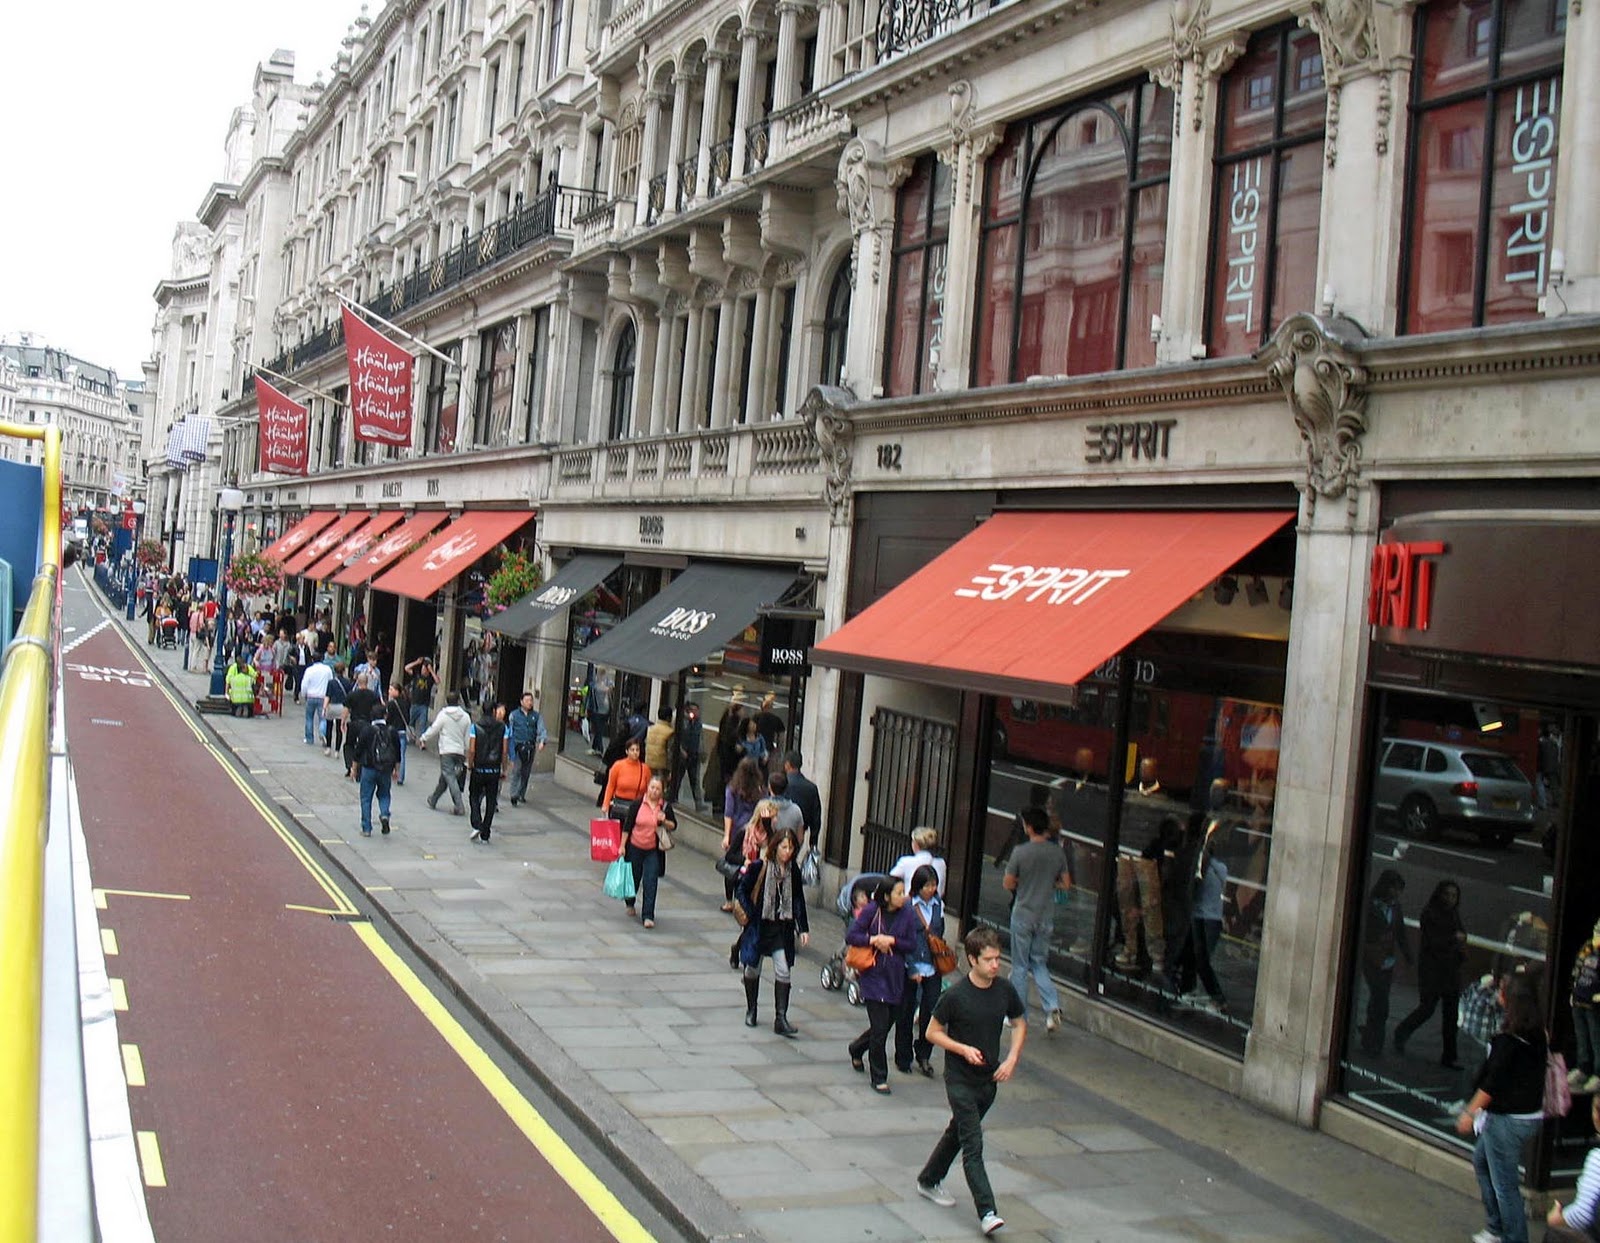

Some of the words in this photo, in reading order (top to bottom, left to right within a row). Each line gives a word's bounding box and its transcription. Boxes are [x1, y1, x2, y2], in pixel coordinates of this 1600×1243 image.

[1505, 78, 1556, 295] ESPRIT
[1225, 158, 1261, 333] ESPRIT
[353, 345, 405, 378] Hamleys
[354, 368, 406, 402] Hamleys
[356, 393, 406, 428] Hamleys
[1085, 418, 1178, 464] ESPRIT
[954, 564, 1131, 605] ESPRIT
[657, 607, 716, 634] BOSS
[771, 648, 803, 661] BOSS
